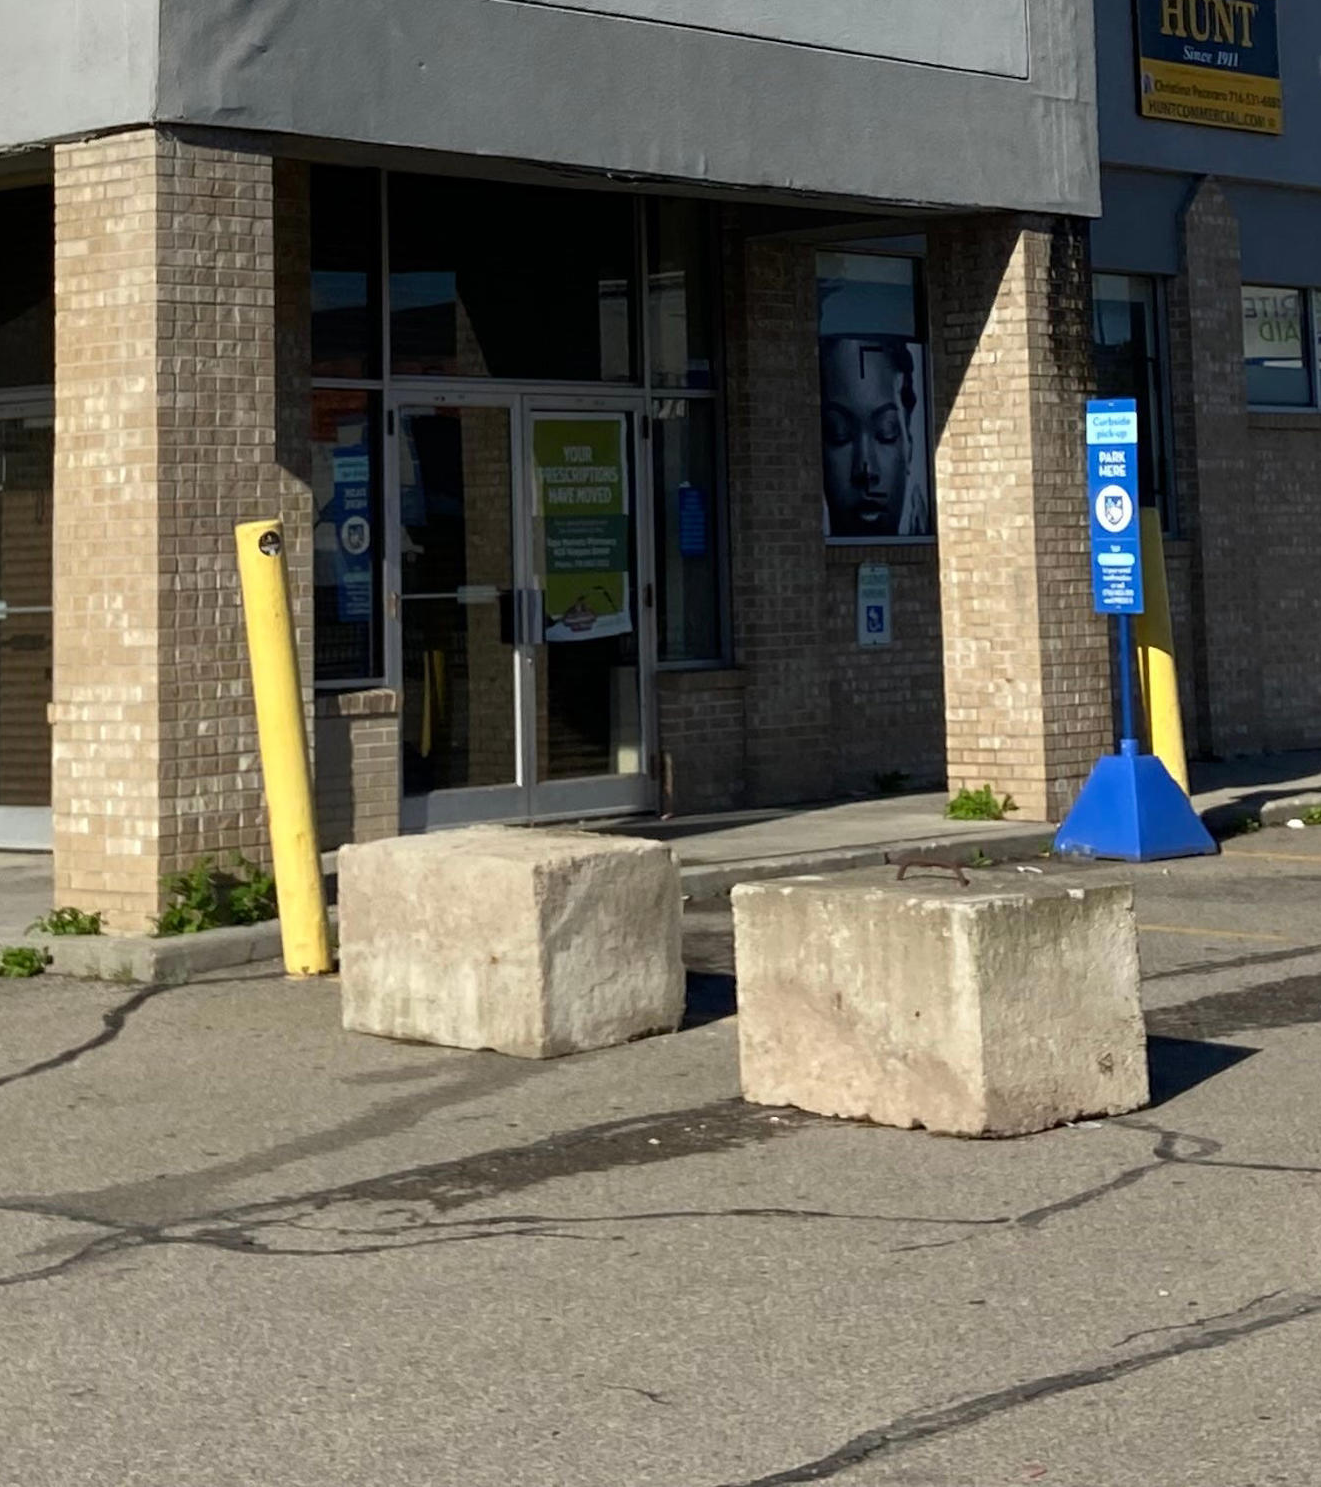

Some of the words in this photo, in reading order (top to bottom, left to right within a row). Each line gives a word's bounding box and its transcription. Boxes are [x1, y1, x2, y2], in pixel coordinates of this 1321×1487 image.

[1182, 44, 1213, 64] Since
[1216, 50, 1239, 68] 1911
[1148, 100, 1266, 129] HUNTCOMMERCIAL.COM
[1092, 416, 1132, 427] Curbside
[1096, 427, 1128, 441] pick-up
[563, 444, 593, 464] YOUR
[1099, 450, 1127, 464] PARK
[537, 464, 618, 484] PRESCRIPTIONS
[1099, 464, 1127, 478] HERE
[549, 486, 576, 505] HAVE
[576, 485, 612, 504] MOVED
